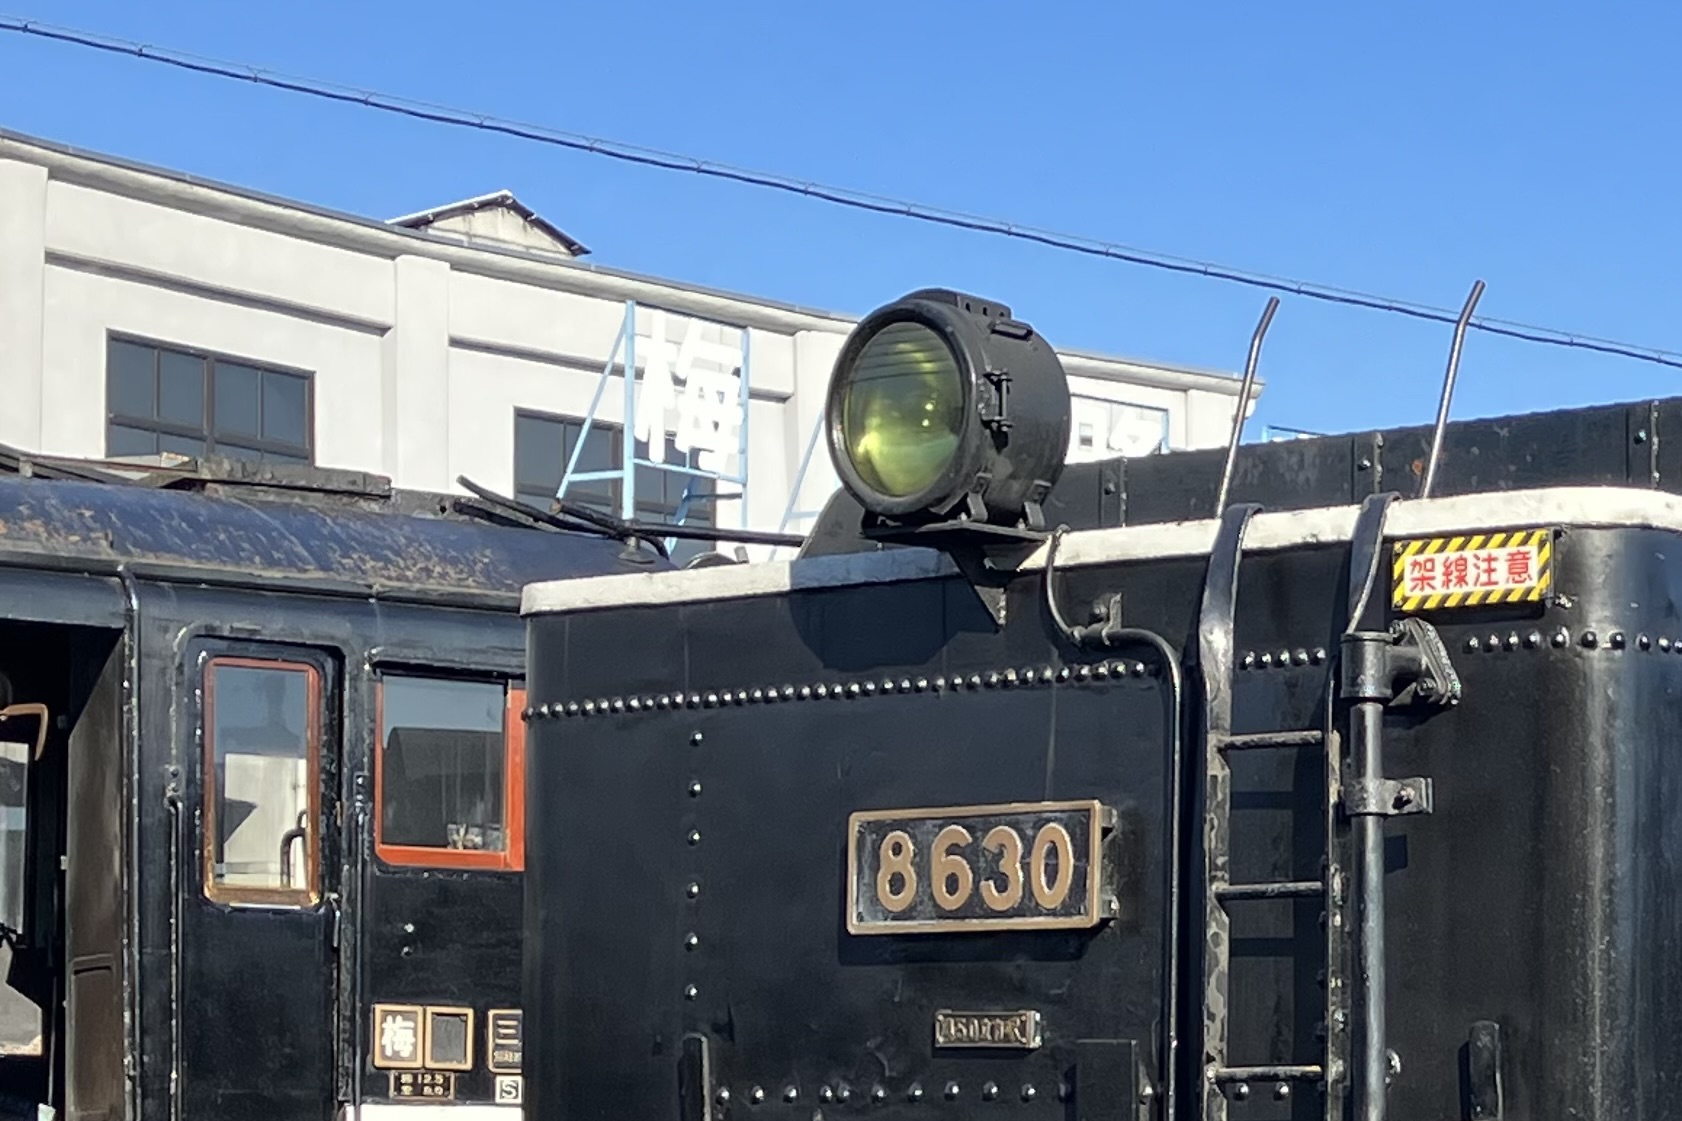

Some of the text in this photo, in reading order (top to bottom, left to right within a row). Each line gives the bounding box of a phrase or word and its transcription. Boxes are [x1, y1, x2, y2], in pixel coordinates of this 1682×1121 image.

[1409, 548, 1534, 593] 架線注意
[876, 821, 1076, 913] 8630
[381, 1013, 417, 1059] 梅
[500, 1079, 519, 1100] S
